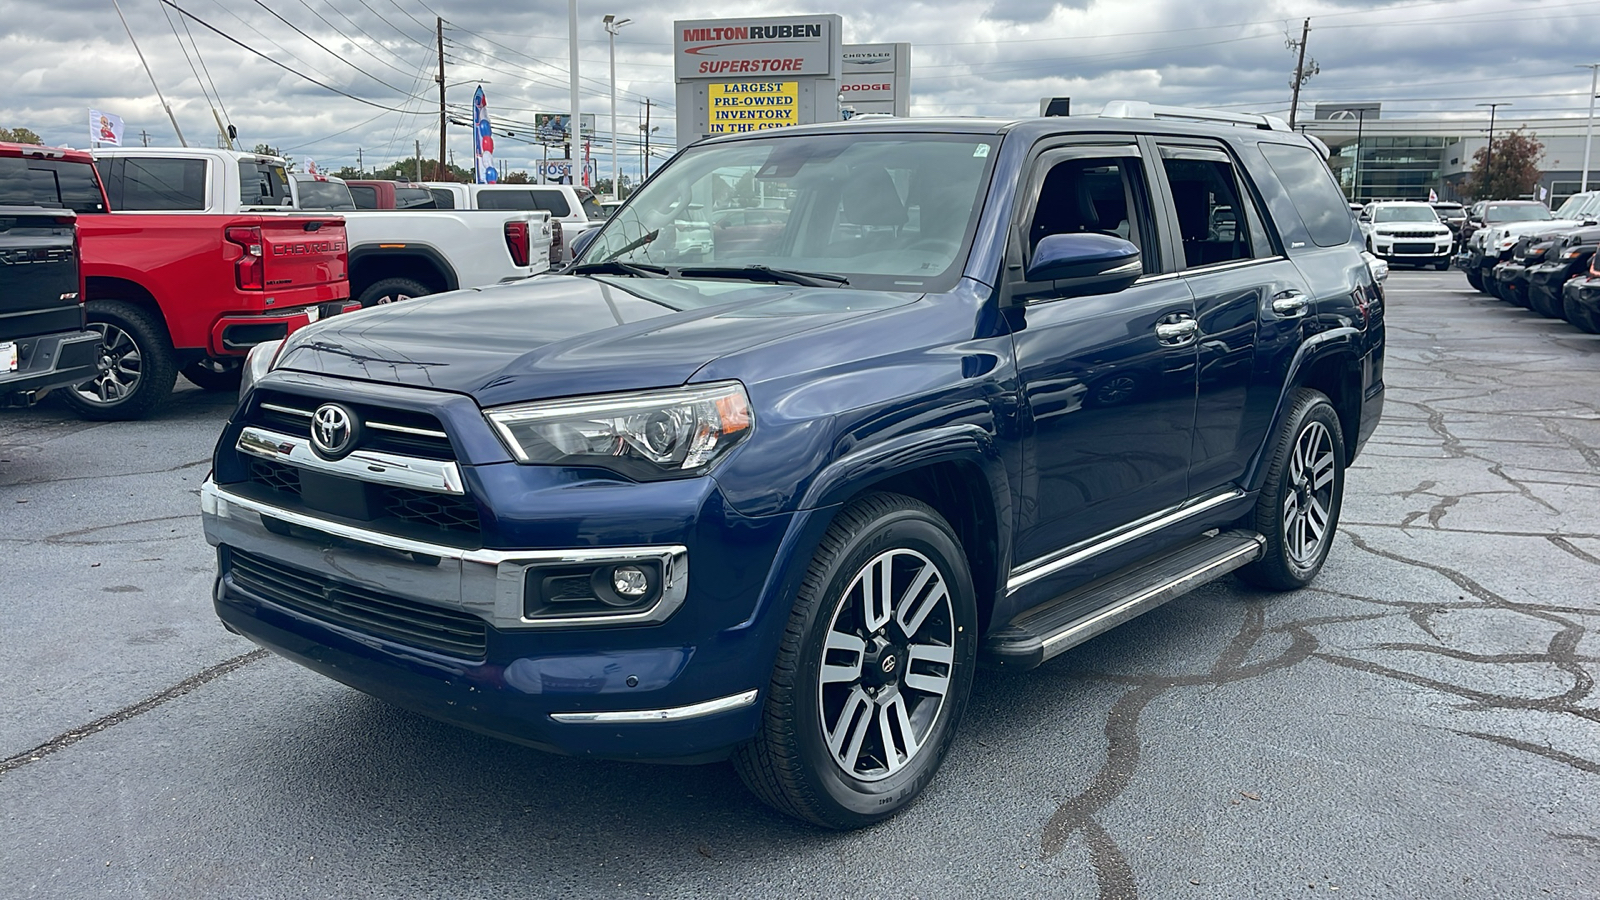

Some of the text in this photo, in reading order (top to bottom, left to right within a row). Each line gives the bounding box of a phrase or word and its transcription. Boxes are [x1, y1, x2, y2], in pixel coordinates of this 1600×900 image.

[683, 24, 821, 42] MILTON RUBEN
[698, 58, 804, 73] SUPERSTORE
[724, 83, 783, 92] LARGEST
[714, 96, 793, 106] PRE-OWNED
[716, 109, 792, 119] INVENTORY
[711, 124, 724, 132] IN
[728, 123, 755, 132] THE
[273, 242, 345, 255] CHEVROLET
